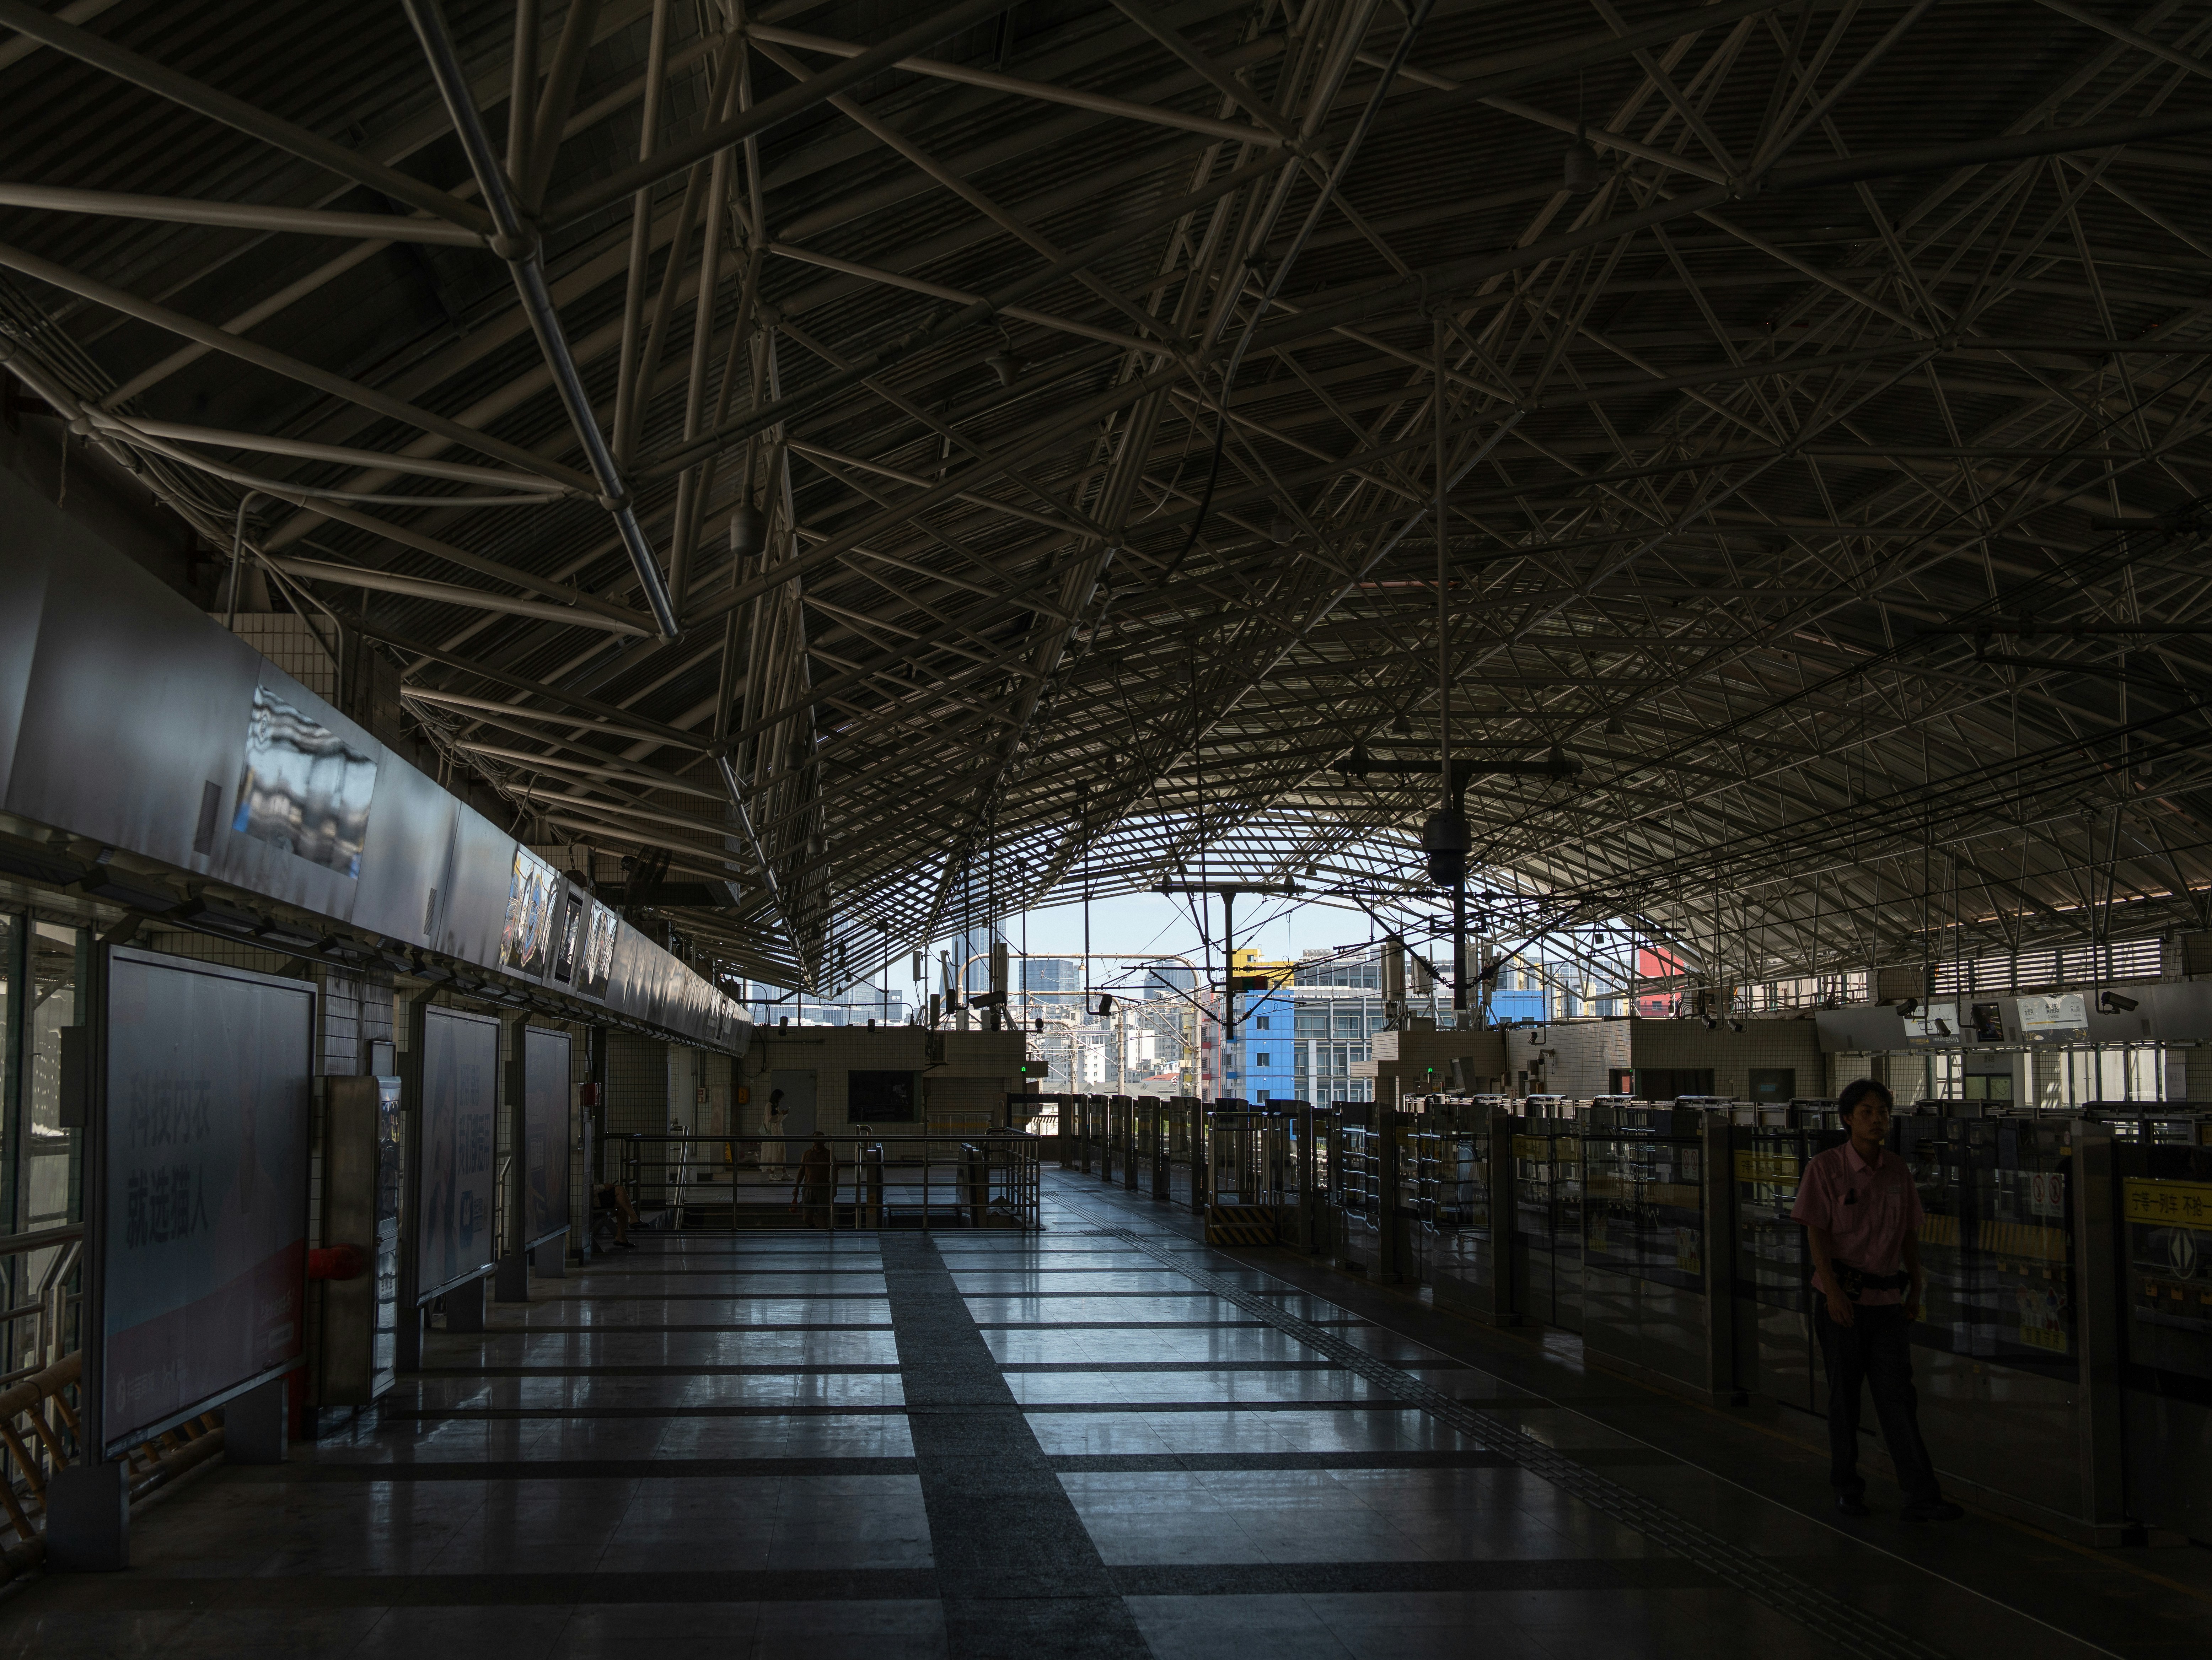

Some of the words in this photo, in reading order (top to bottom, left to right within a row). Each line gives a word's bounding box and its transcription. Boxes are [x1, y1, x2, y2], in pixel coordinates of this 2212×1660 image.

[128, 1068, 211, 1149] 科技内衣
[126, 1162, 209, 1249] 就选猫人
[2132, 1191, 2178, 1214] 宁等一列车
